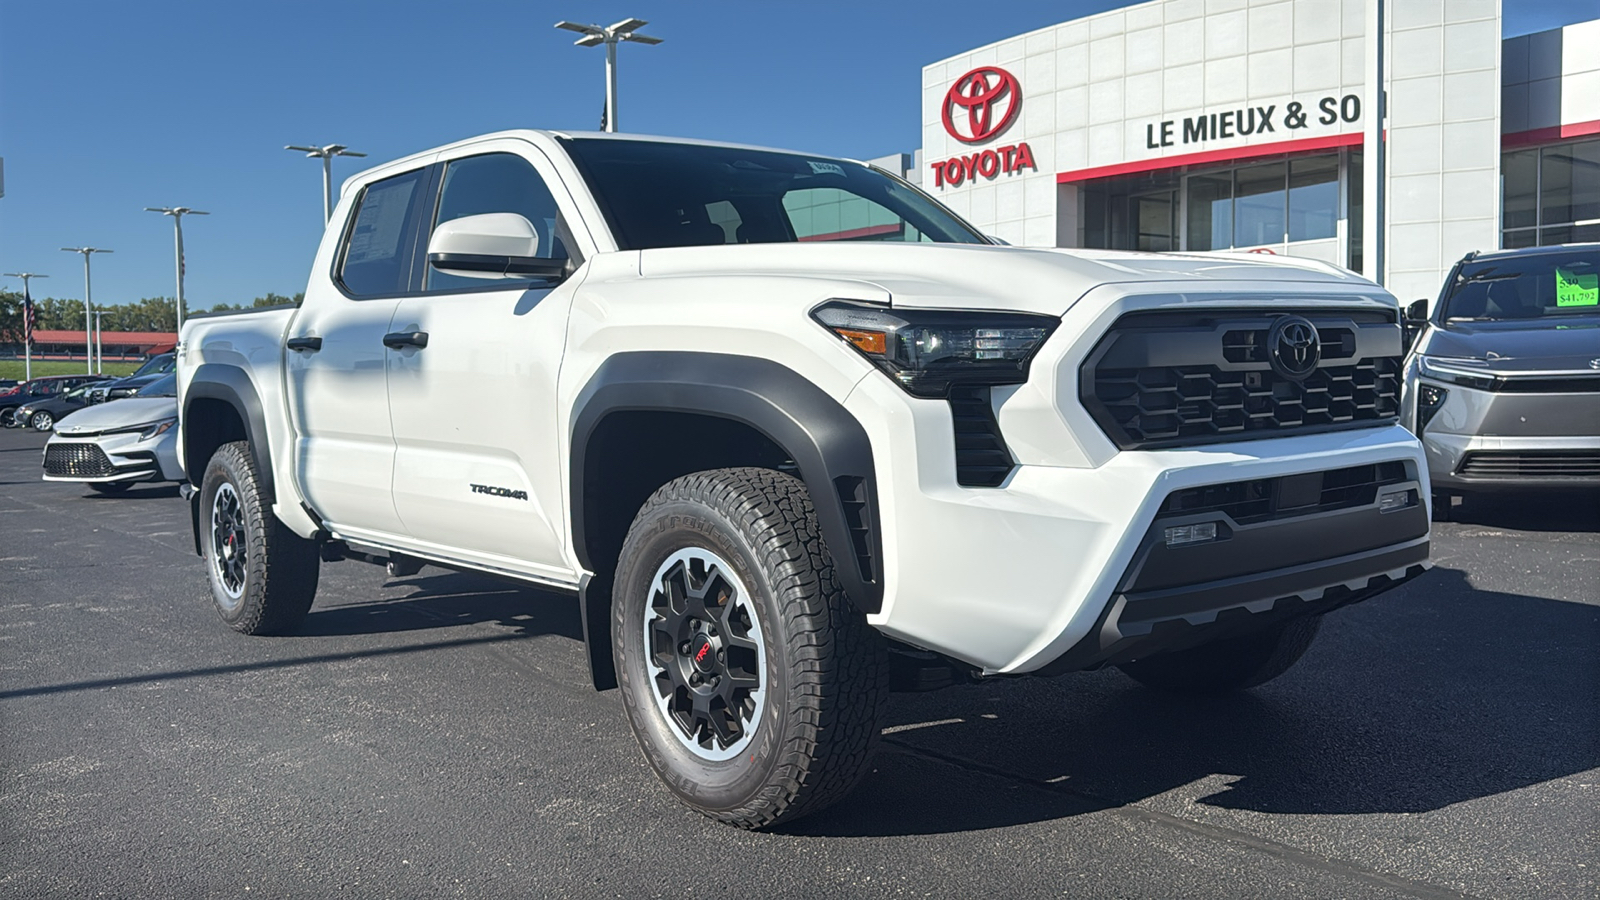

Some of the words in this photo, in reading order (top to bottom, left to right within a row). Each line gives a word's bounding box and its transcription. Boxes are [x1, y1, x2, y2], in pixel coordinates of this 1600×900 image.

[1147, 120, 1174, 149] LE
[1183, 105, 1276, 144] MIEUX
[1284, 101, 1308, 130] &
[931, 142, 1036, 189] TOYOTA
[470, 483, 528, 501] TACOMA
[695, 642, 710, 662] TRD
